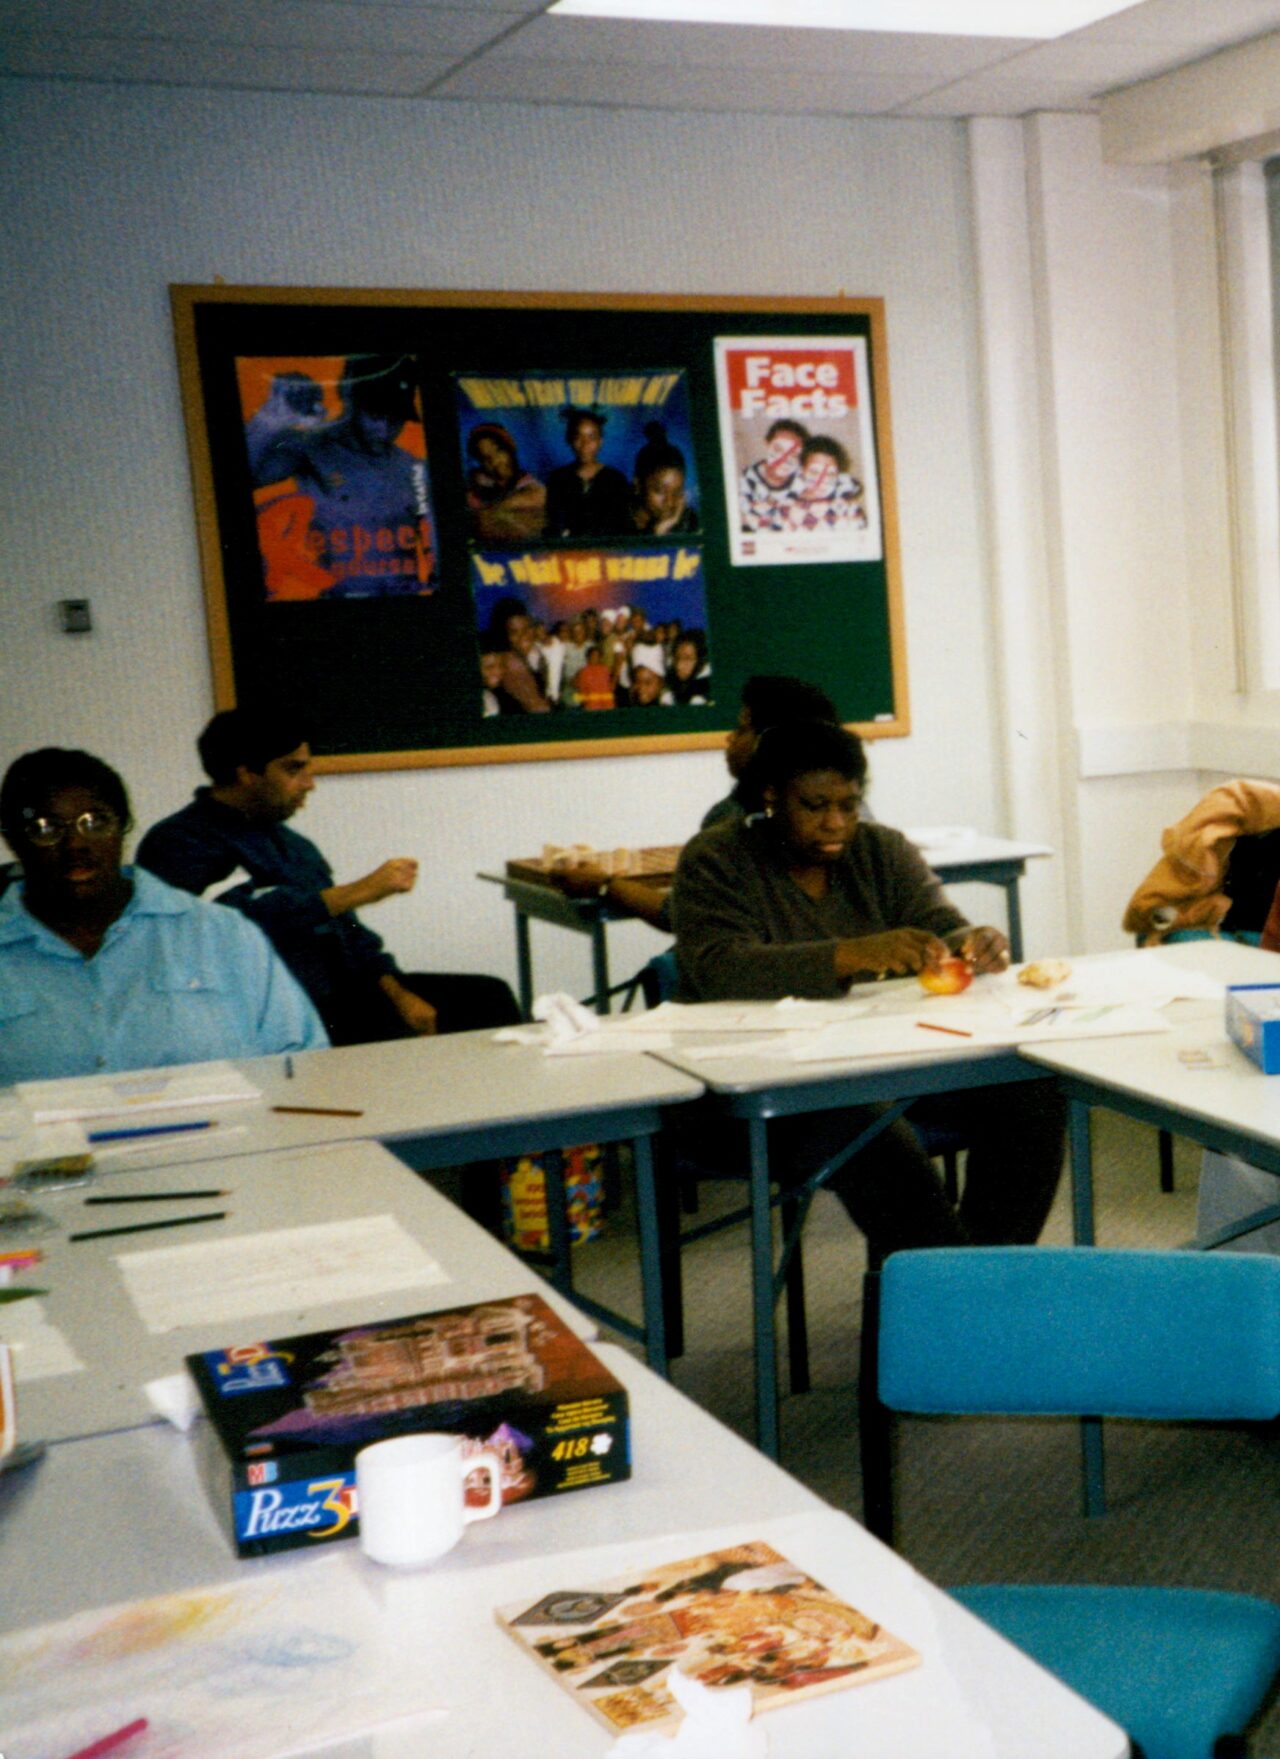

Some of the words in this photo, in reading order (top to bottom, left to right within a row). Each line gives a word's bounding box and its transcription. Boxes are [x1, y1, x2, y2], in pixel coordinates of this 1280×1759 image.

[744, 356, 839, 388] Face
[740, 386, 849, 420] Facts
[551, 1437, 589, 1461] 418
[248, 1461, 278, 1486] MB
